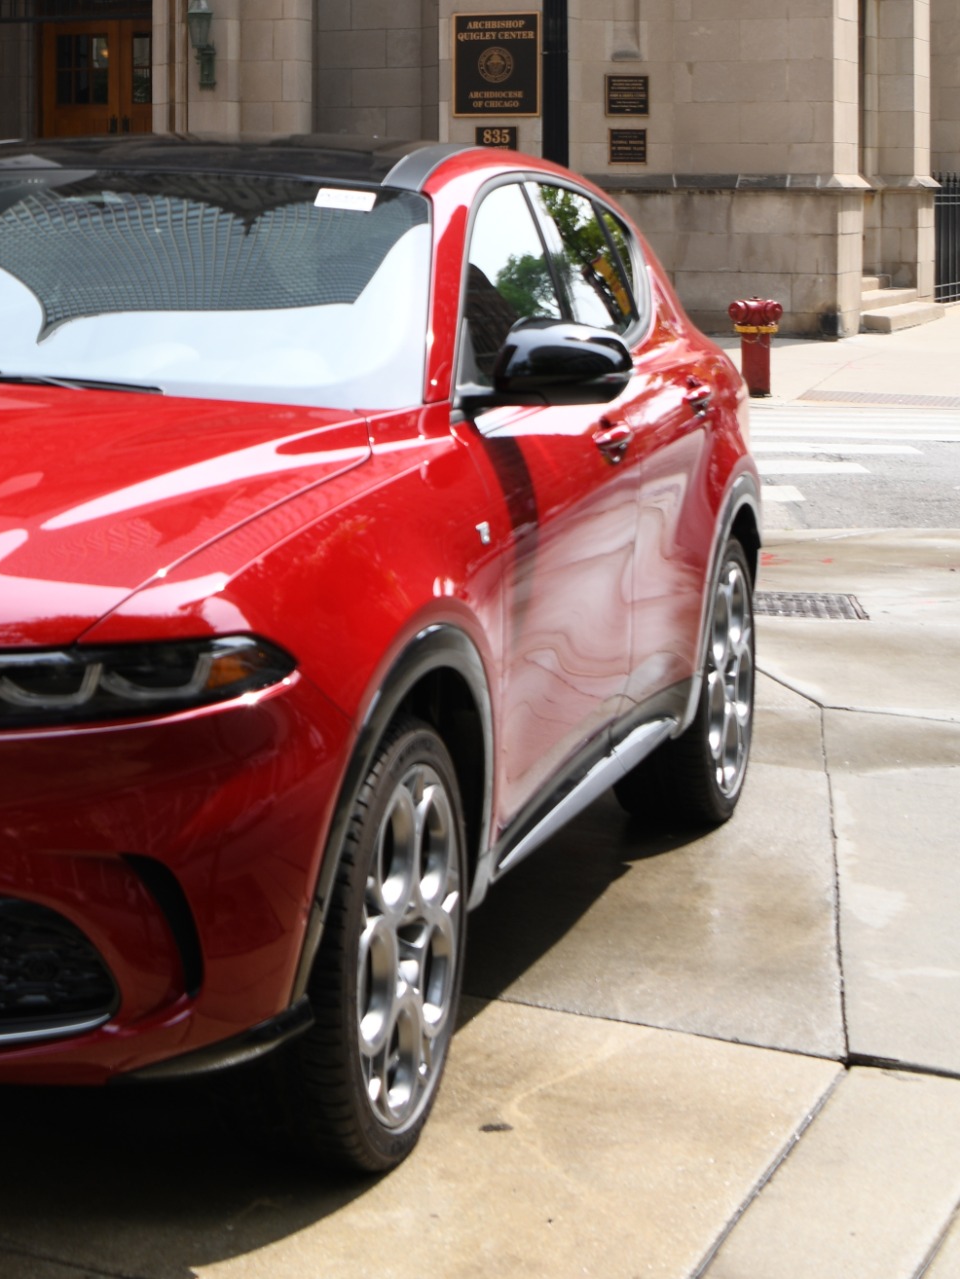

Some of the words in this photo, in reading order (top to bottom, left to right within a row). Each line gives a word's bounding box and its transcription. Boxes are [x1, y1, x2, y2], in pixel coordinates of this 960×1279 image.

[466, 20, 526, 30] ARCHBISHOP
[457, 31, 497, 42] QUIGLEY
[498, 30, 535, 40] CENTER
[468, 90, 524, 99] ARCHDIOCESE
[472, 100, 483, 108] OF
[484, 100, 520, 108] CHICAGO
[483, 128, 511, 144] 835
